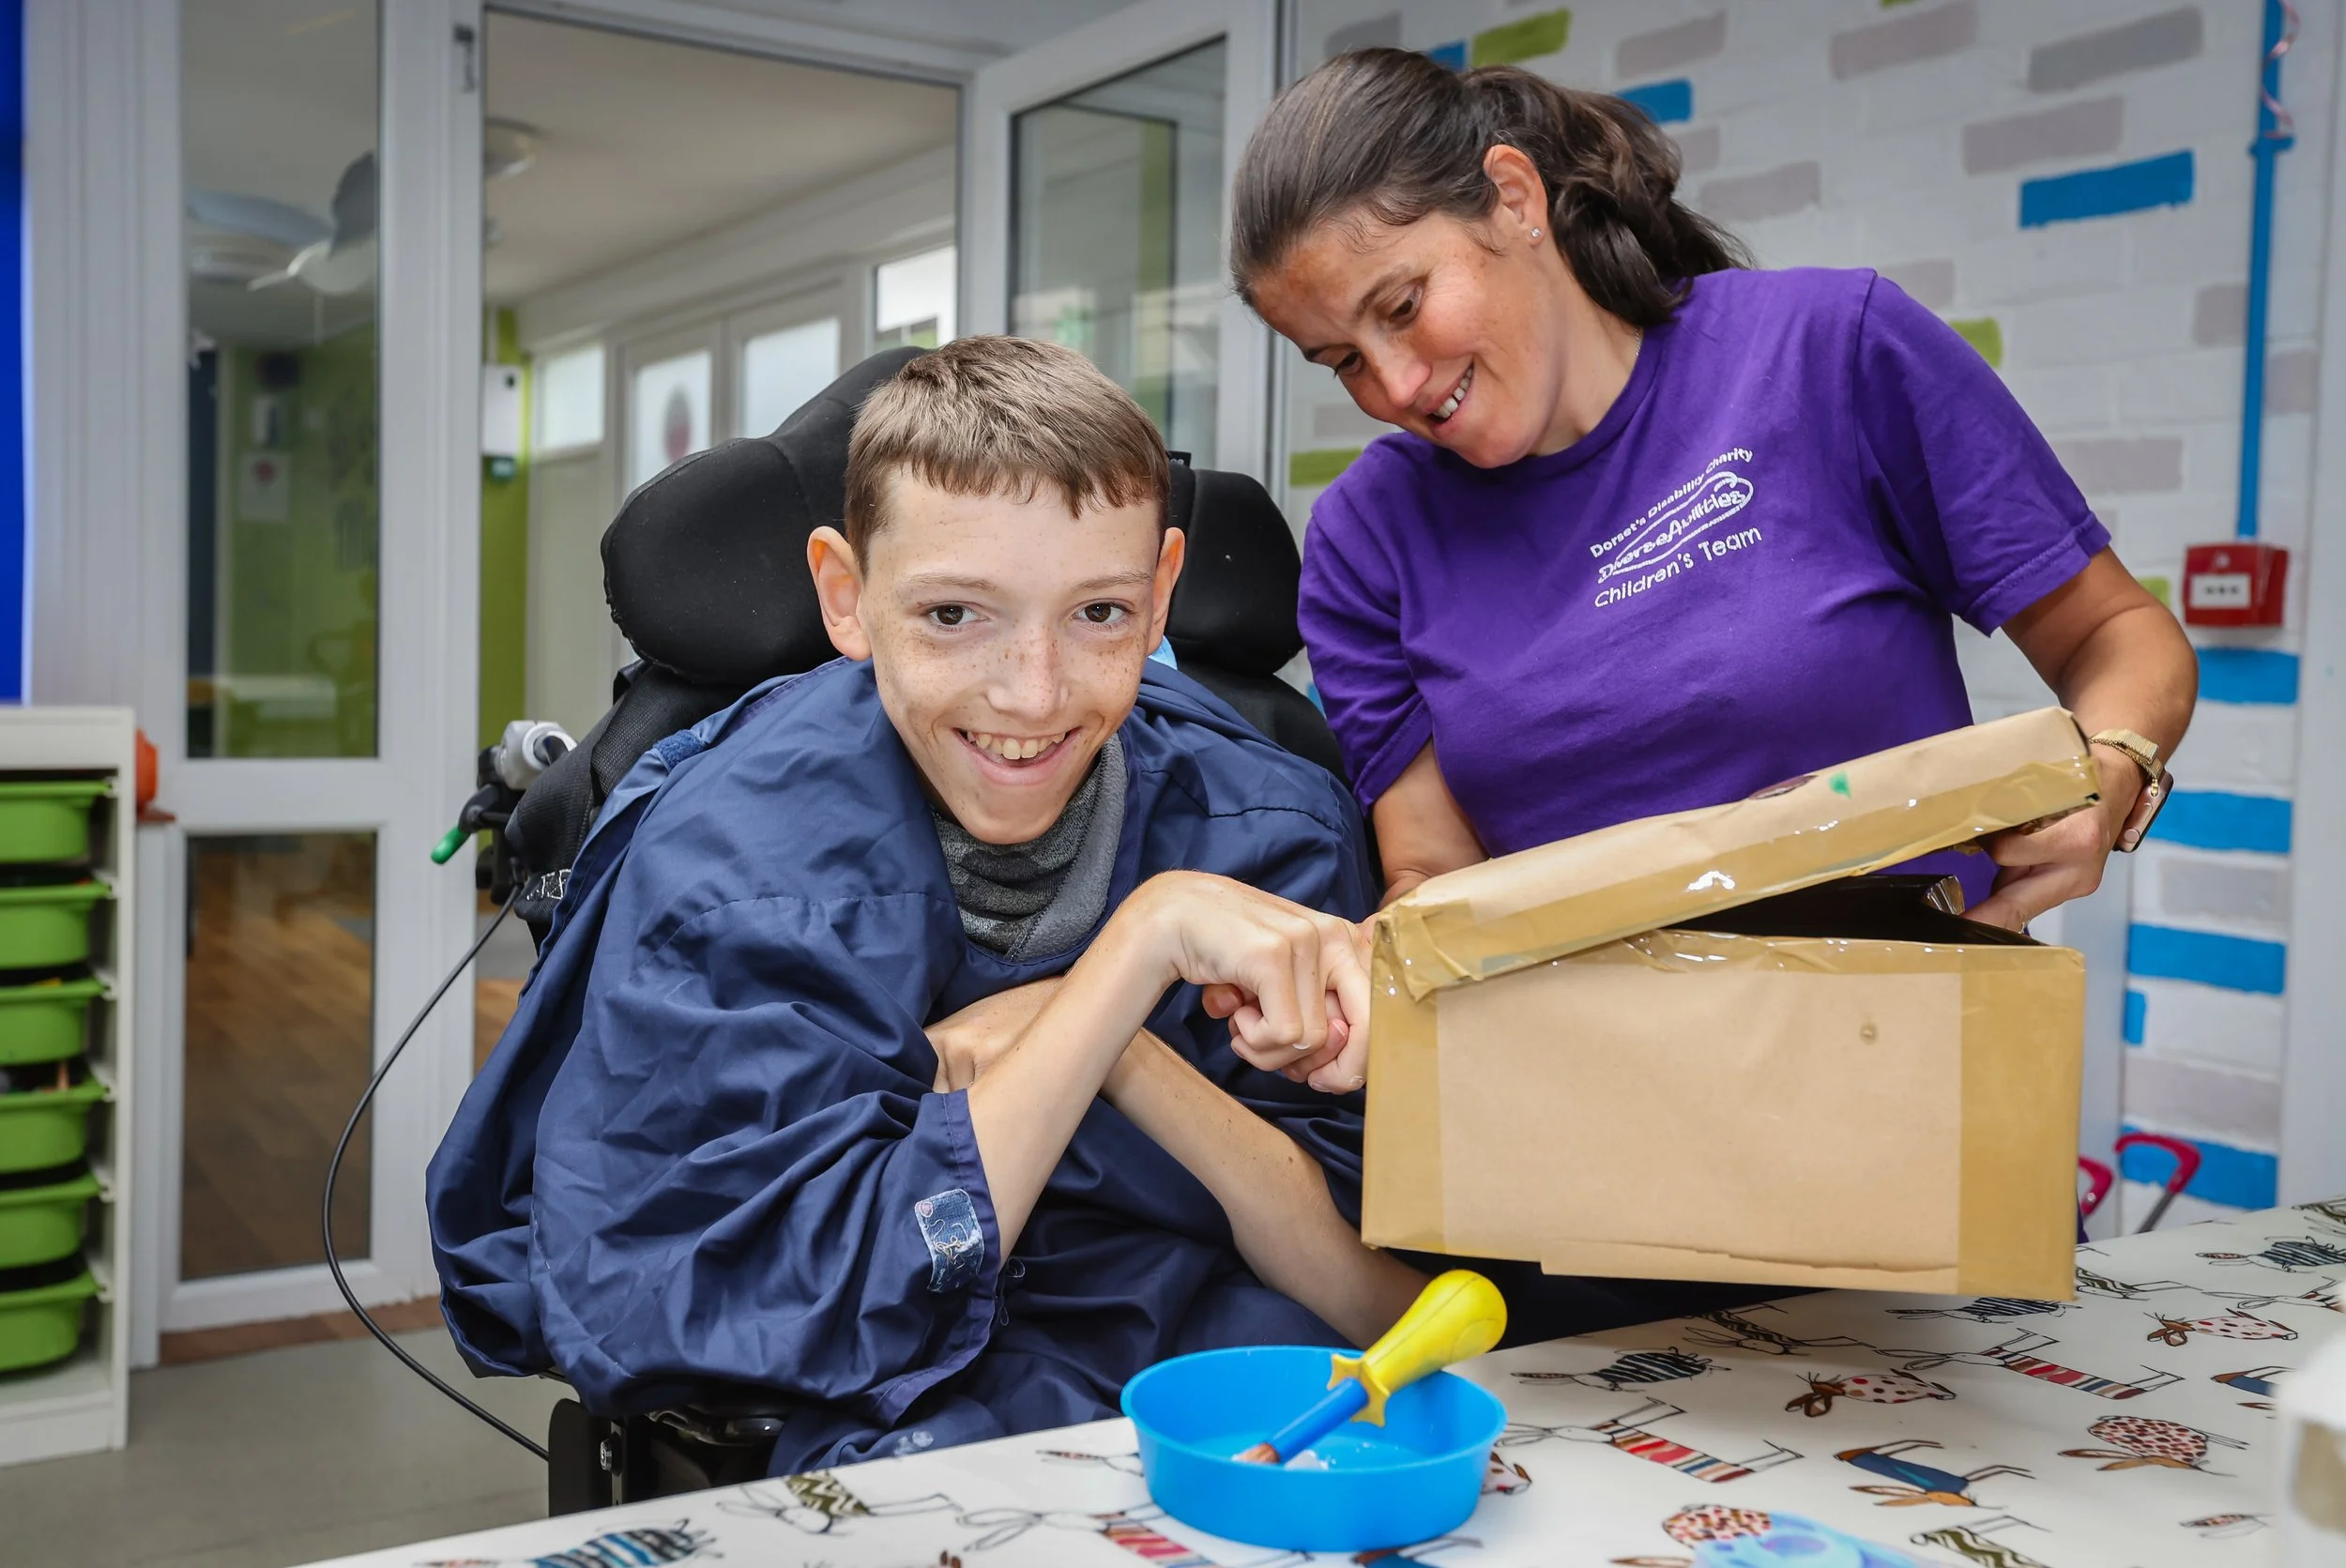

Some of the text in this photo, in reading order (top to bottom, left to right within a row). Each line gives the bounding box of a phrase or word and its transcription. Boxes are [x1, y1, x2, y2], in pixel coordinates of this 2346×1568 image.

[1590, 517, 1646, 557] Dorset's
[1648, 474, 1704, 518] Disability
[1595, 527, 1762, 607] Children's Team
